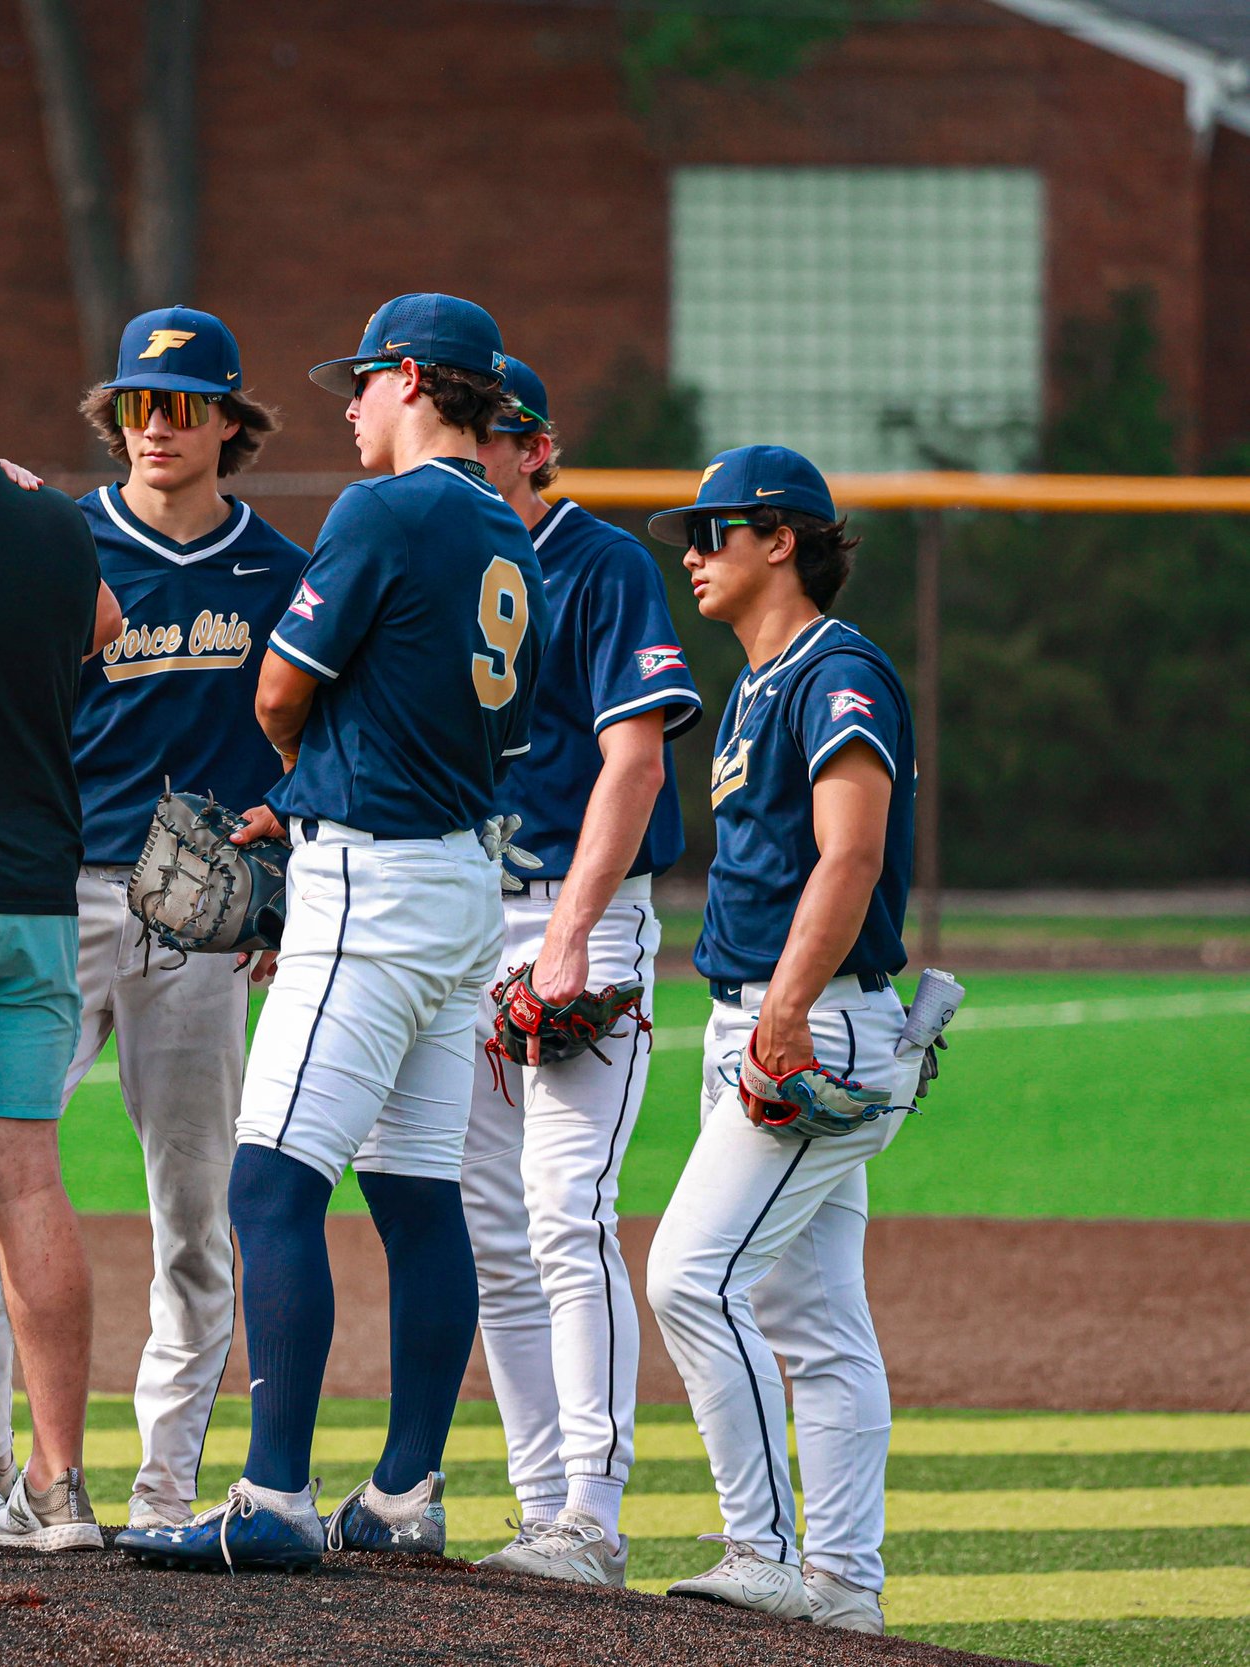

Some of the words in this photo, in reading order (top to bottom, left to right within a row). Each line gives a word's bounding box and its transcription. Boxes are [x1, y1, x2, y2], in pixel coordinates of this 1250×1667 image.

[138, 329, 197, 360] F
[102, 617, 184, 664] Force
[188, 609, 252, 656] Ohio
[471, 554, 530, 712] 9
[69, 1487, 79, 1520] alance
